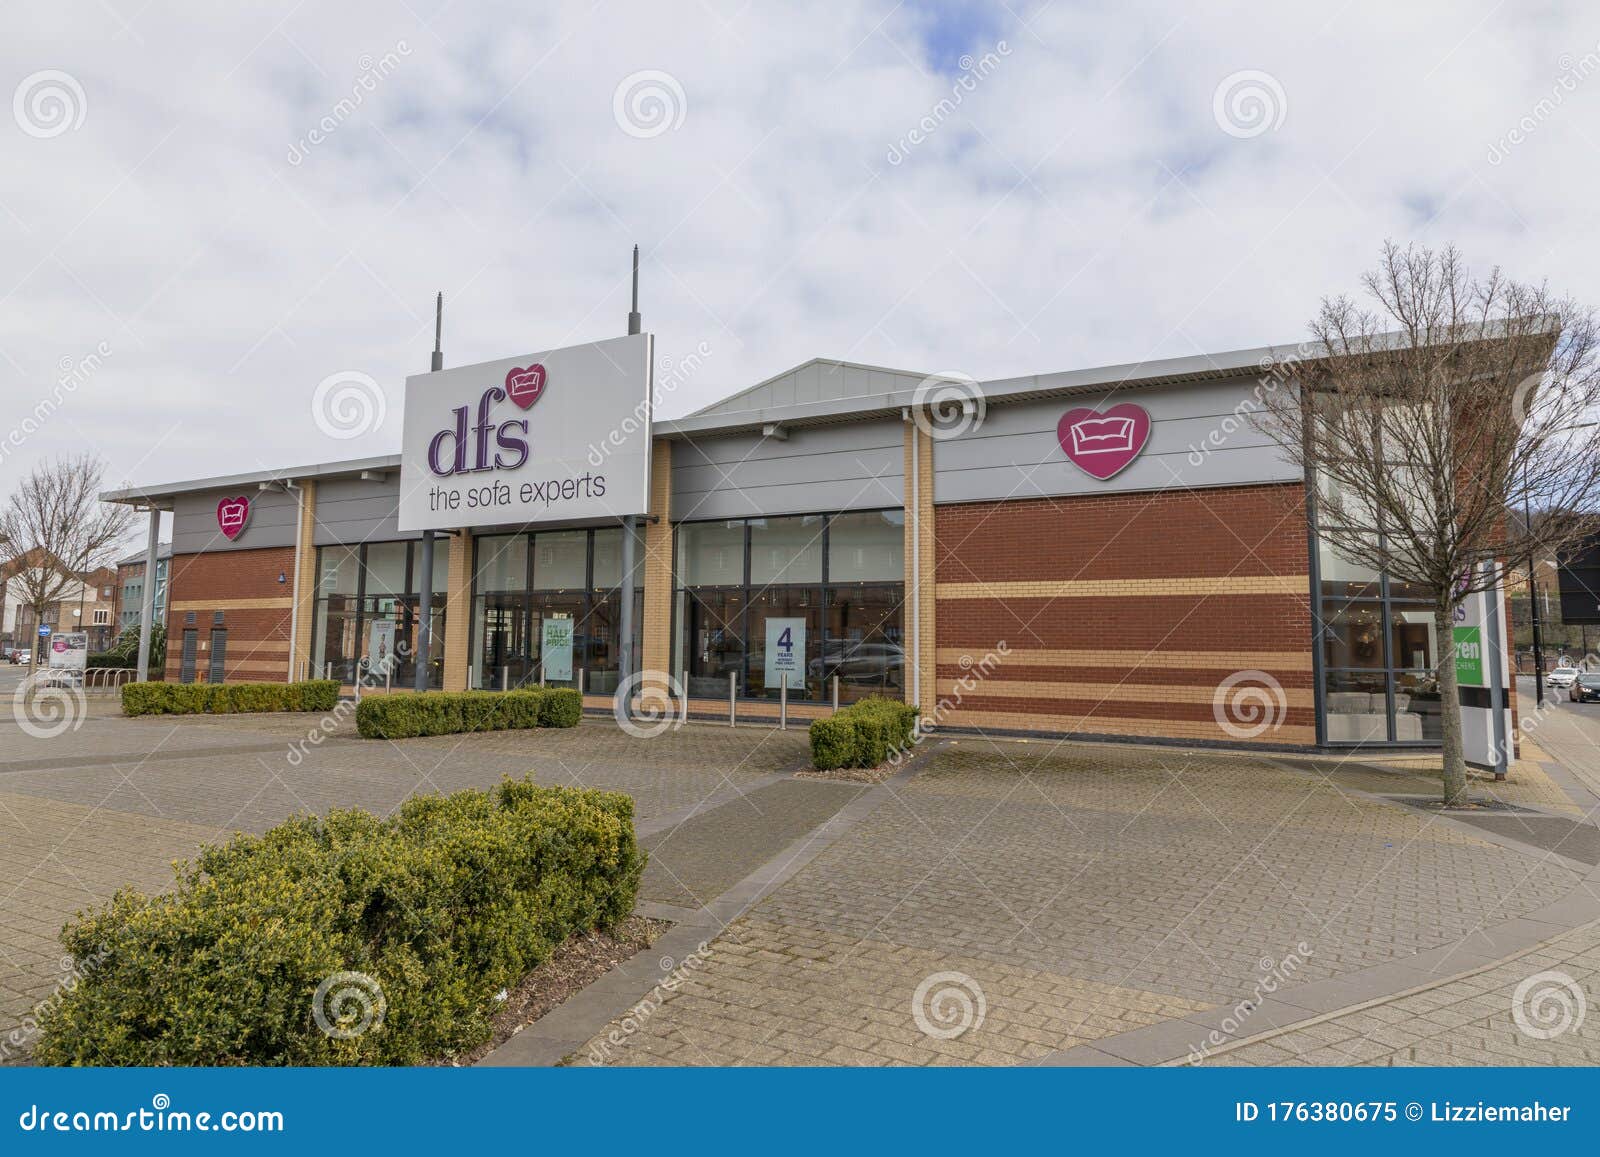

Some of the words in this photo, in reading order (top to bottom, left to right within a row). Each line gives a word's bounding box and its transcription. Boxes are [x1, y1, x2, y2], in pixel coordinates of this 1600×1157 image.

[428, 386, 530, 478] dfs
[429, 485, 461, 511] the
[467, 480, 511, 508] sofa
[520, 471, 606, 508] experts
[777, 627, 793, 652] 4
[1455, 641, 1479, 659] ren
